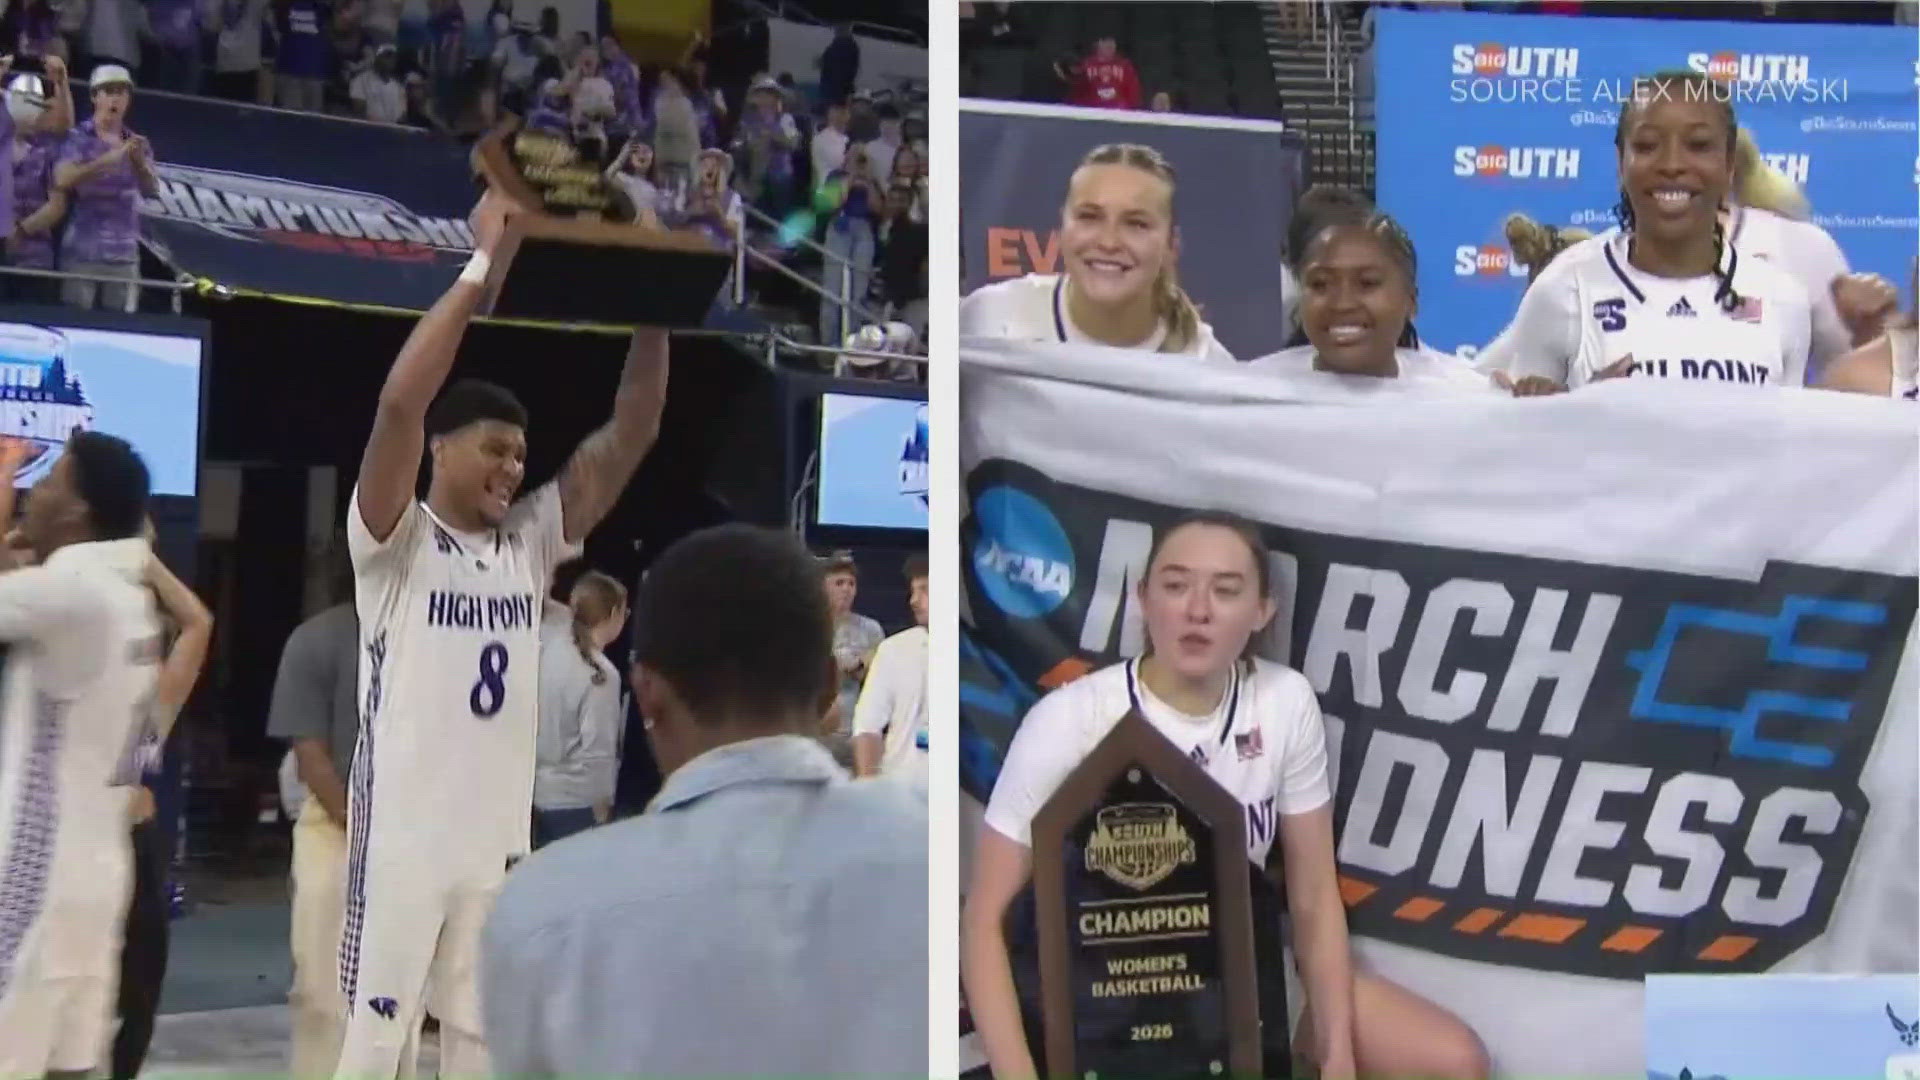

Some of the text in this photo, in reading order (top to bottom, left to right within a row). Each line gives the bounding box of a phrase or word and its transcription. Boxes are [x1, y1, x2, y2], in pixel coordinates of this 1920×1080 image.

[428, 587, 535, 632] HIGH POINT
[470, 640, 509, 719] 8
[1078, 903, 1211, 936] CHAMPION
[1106, 952, 1188, 976] WOMEN'S
[1091, 974, 1206, 999] BASKETBALL
[1130, 1022, 1174, 1042] 2026
